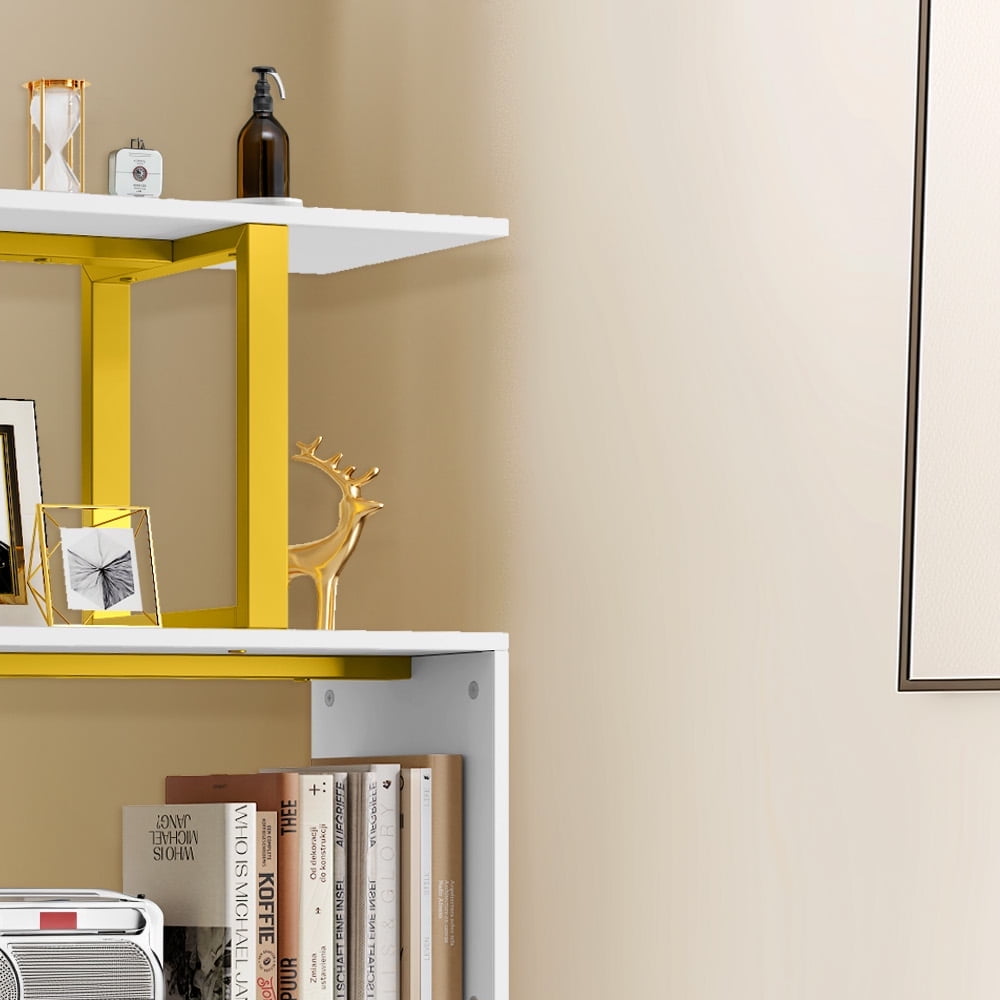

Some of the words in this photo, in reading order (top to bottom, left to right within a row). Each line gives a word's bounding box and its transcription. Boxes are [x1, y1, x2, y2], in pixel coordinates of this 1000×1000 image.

[156, 814, 191, 829] JANG?
[281, 800, 297, 836] THEE
[235, 805, 248, 855] WHO
[148, 831, 198, 845] MICHAEL
[310, 827, 318, 865] dekoracji
[153, 847, 163, 861] IS
[166, 847, 194, 861] WHO
[235, 861, 248, 877] IS
[310, 867, 317, 880] Od
[321, 873, 327, 882] do
[259, 873, 275, 944] KOFFIE
[235, 882, 248, 970] MICHAEL
